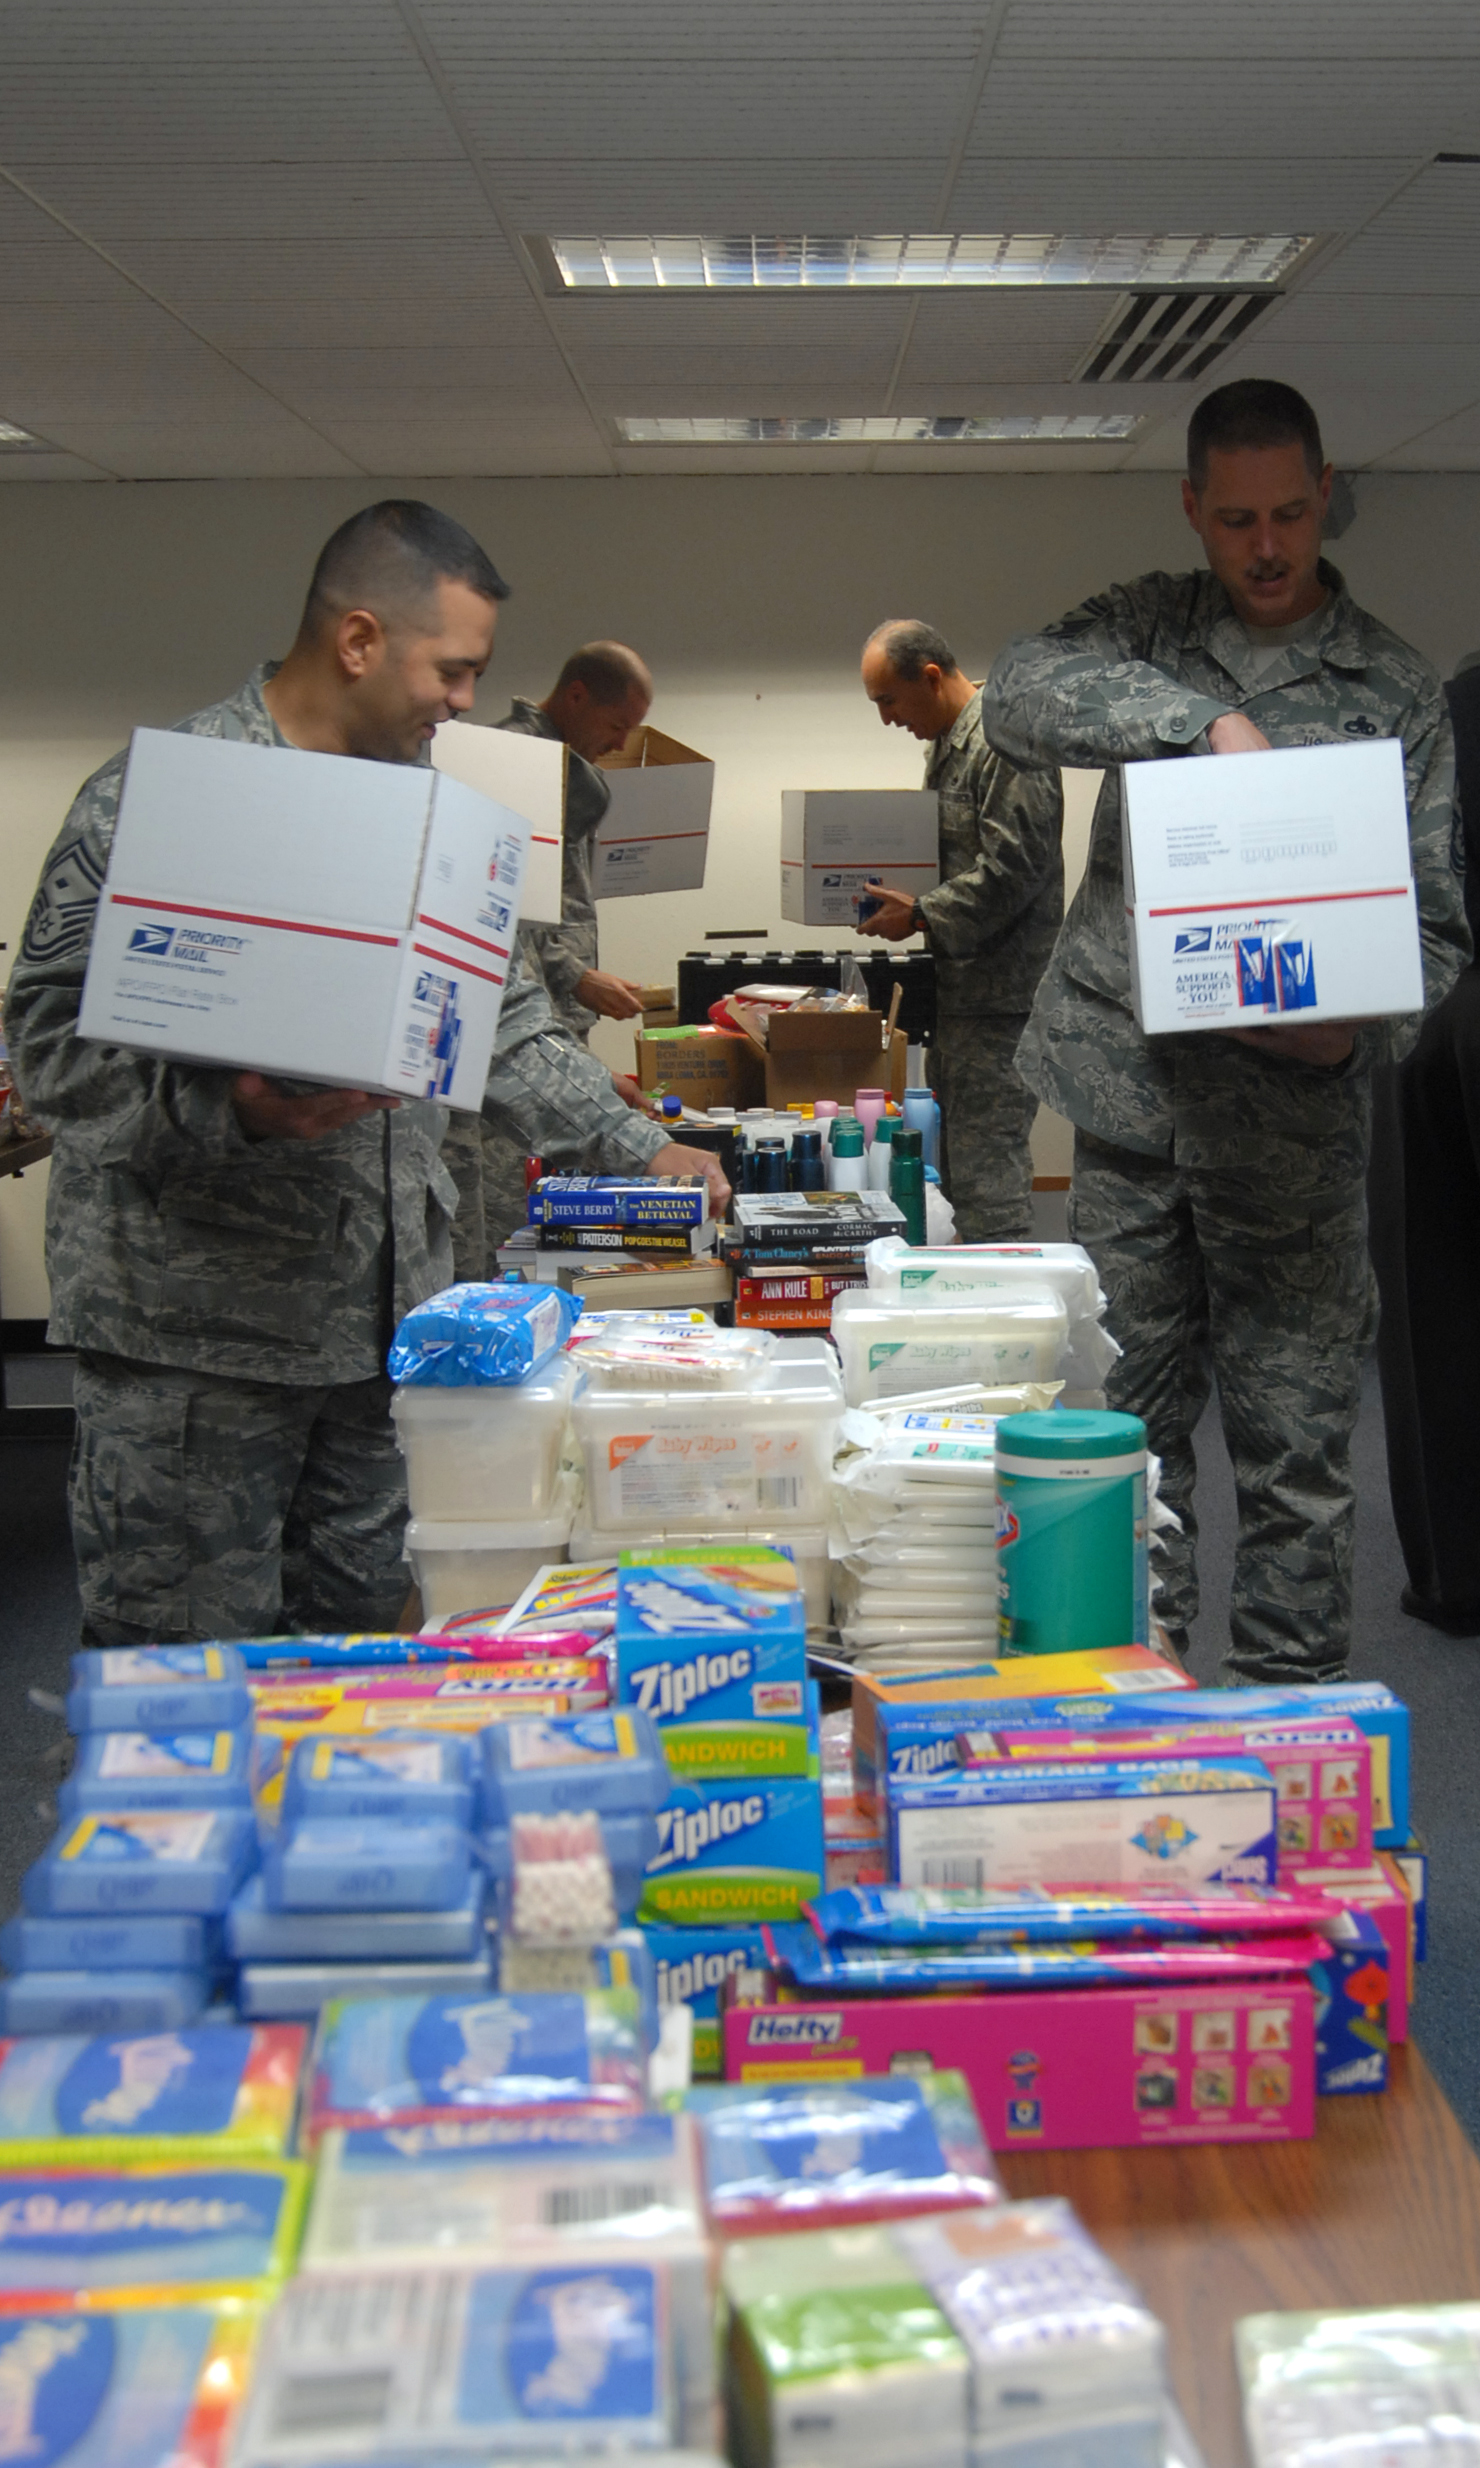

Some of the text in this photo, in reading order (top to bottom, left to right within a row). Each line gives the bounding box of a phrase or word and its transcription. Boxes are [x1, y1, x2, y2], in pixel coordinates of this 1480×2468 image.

[177, 929, 245, 950] PRIORITY
[1176, 970, 1230, 984] AMERICA
[1176, 981, 1231, 994] SUPPORTS
[1189, 991, 1219, 1004] YOU
[656, 1050, 706, 1060] BORDERS
[553, 1204, 614, 1216] STEVE BERRY
[640, 1199, 697, 1209] VENETIAN
[637, 1210, 694, 1220] BETRAYAL
[770, 1227, 819, 1237] THE ROAD
[836, 1223, 873, 1231] CORMAC
[582, 1232, 623, 1247] PATTERSON
[624, 1236, 636, 1246] POP
[754, 1246, 810, 1261] Tom Clancy's
[811, 1245, 851, 1253] SPLINTER
[761, 1281, 783, 1300] ANN
[784, 1280, 808, 1298] RULE
[831, 1280, 844, 1290] BUT
[757, 1307, 832, 1321] STEPHEN KING
[656, 1435, 737, 1454] Baby Wipes
[630, 1648, 751, 1720] Ziploc
[666, 1738, 787, 1764] ANDWICH
[645, 1794, 764, 1874] Ziploc
[656, 1885, 798, 1911] SANDWICH
[755, 2019, 834, 2044] Hefty
